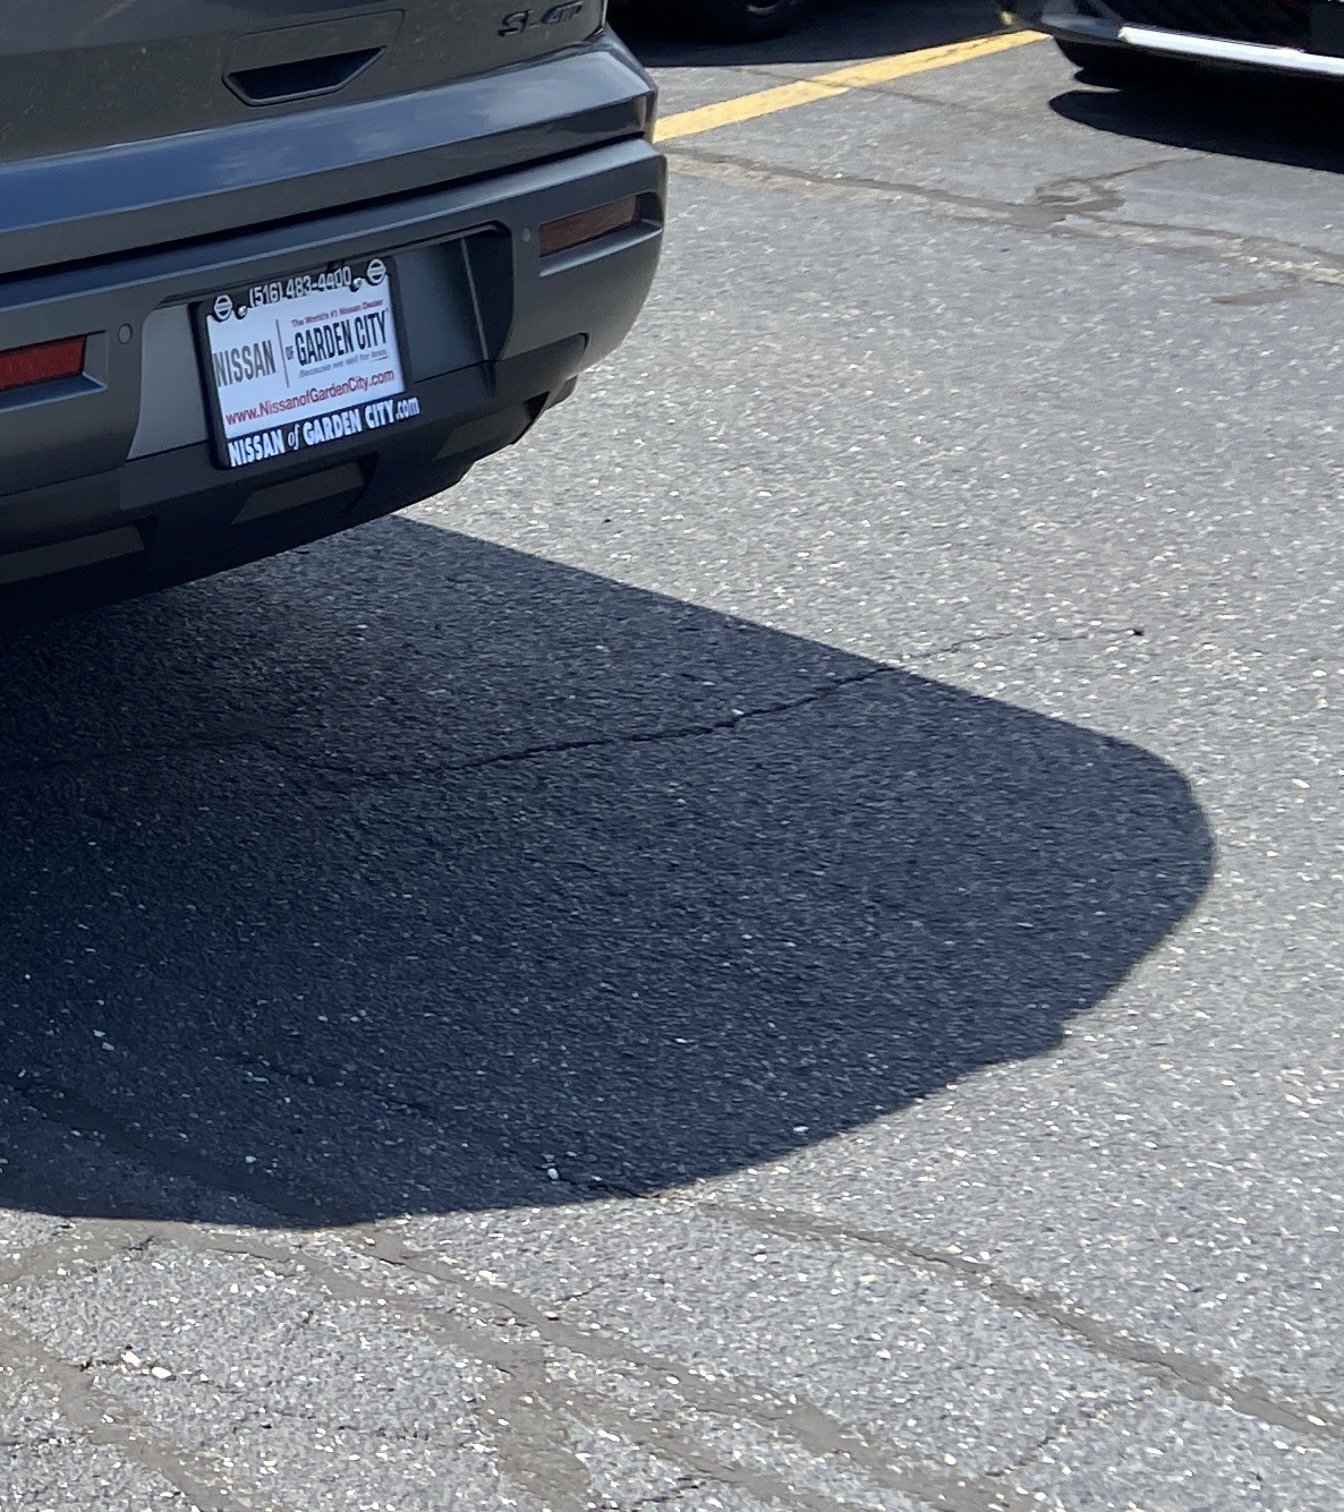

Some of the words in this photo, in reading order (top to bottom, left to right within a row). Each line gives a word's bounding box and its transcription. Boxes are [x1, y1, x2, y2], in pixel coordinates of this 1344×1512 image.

[213, 339, 276, 388] NISSAN
[294, 319, 355, 367] GARDEN
[354, 309, 387, 351] CITY
[226, 369, 396, 426] www.NissanofGardenCity.com
[227, 429, 285, 468] NISSAN
[288, 423, 301, 451] of
[302, 408, 362, 446] GARDEN
